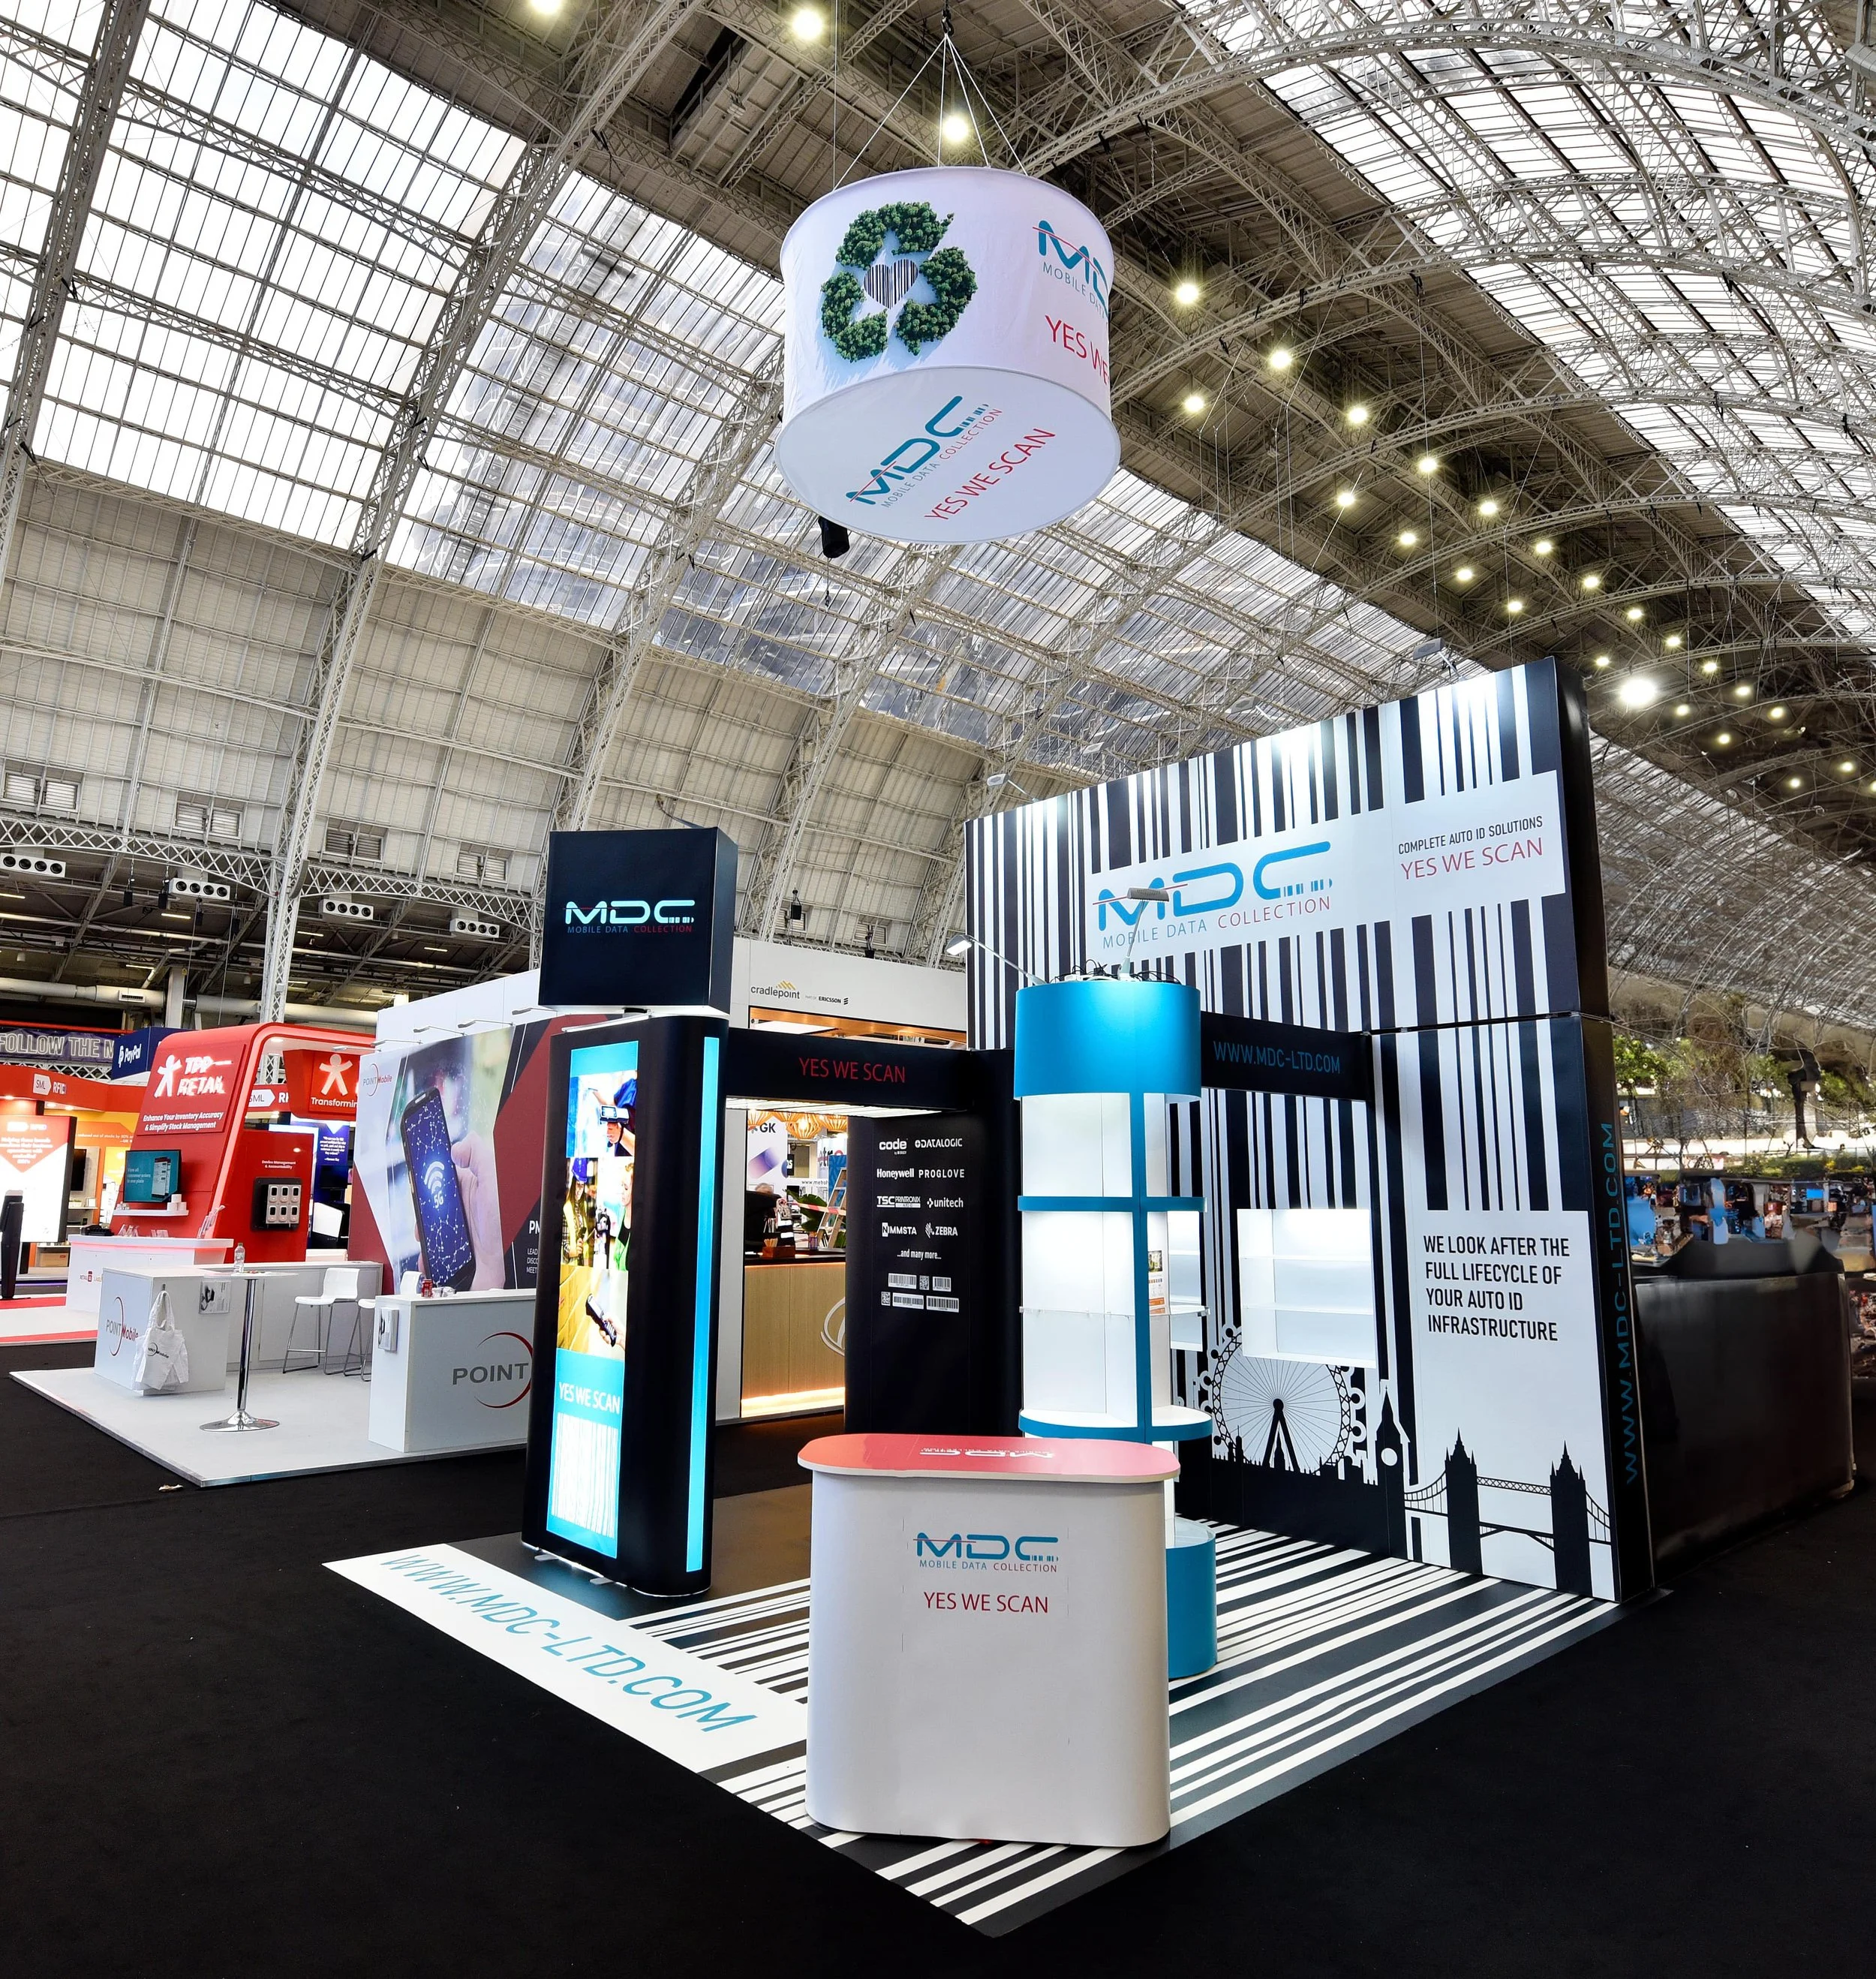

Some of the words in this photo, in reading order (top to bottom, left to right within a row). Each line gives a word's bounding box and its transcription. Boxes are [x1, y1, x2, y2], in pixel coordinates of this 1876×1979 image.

[1043, 261, 1086, 296] MOBILE
[1045, 315, 1087, 359] YES
[1090, 341, 1108, 385] WE
[846, 395, 989, 505] MDC
[881, 482, 915, 508] MOBILE
[912, 463, 940, 481] DATA
[940, 408, 1003, 460] COLLECTION
[924, 496, 968, 520] YES
[955, 473, 1000, 497] WE
[988, 428, 1056, 474] SCAN
[1399, 835, 1446, 855] COMPLETE
[1449, 829, 1473, 845] AUTO
[1476, 828, 1486, 840] ID
[1489, 816, 1543, 838] SOLUTIONS
[1401, 857, 1437, 880] YES
[1442, 850, 1476, 873] WE
[1482, 837, 1543, 866] SCAN
[1099, 841, 1332, 931] MDC
[565, 900, 696, 925] MDC
[1102, 927, 1159, 949] MOBILE
[1167, 919, 1207, 938] DATA
[1218, 895, 1330, 929] COLLECTION
[567, 925, 601, 934] MOBILE
[605, 925, 629, 934] DATA
[633, 925, 692, 933] COLLECTION
[750, 986, 800, 1000] cradlepoint
[68, 1036, 100, 1057] THE
[124, 1043, 142, 1064] PayPal
[1213, 1040, 1341, 1074] WWW.MDC-LTD.COM
[798, 1057, 829, 1078] YES
[832, 1060, 859, 1080] WE
[863, 1063, 905, 1084] SCAN
[36, 1079, 46, 1090] SML
[149, 1123, 169, 1132] Simplify
[182, 1121, 217, 1131] Management
[175, 1113, 199, 1121] Inventory
[198, 1111, 224, 1120] Accuracy
[759, 1123, 777, 1134] GK
[879, 1138, 907, 1150] code
[921, 1138, 963, 1148] DATALOGIC
[876, 1168, 915, 1180] Honeywell
[918, 1169, 965, 1178] PROGLOVE
[434, 1193, 444, 1209] 5G
[876, 1196, 895, 1205] TSC
[933, 1197, 964, 1208] unitech
[882, 1223, 917, 1237] NIMMSTA
[935, 1226, 958, 1236] ZEBRA
[910, 1250, 924, 1261] many
[1424, 1235, 1445, 1253] WE
[1448, 1236, 1487, 1255] LOOK
[1490, 1237, 1538, 1256] AFTER
[1540, 1238, 1570, 1257] THE
[1426, 1262, 1459, 1280] FULL
[1463, 1263, 1538, 1284] LIFECYCLE
[1542, 1265, 1562, 1285] OF
[1426, 1288, 1463, 1307] YOUR
[1467, 1291, 1505, 1310] AUTO
[1509, 1292, 1523, 1310] ID
[1600, 1123, 1639, 1485] WWW.MDC-LTD.COM
[106, 1319, 121, 1334] POINT
[1428, 1314, 1559, 1341] INFRASTRUCTURE
[452, 1362, 529, 1385] POINT
[559, 1381, 574, 1402] YES
[575, 1386, 591, 1408] WE
[592, 1391, 621, 1415] SCAN
[919, 1450, 1054, 1459] MDC
[917, 1532, 1059, 1562] MDC
[919, 1559, 958, 1569] MOBILE
[961, 1562, 987, 1570] DATA
[994, 1562, 1057, 1573] COLLECTION
[924, 1592, 957, 1611] YES
[961, 1593, 991, 1611] WE
[997, 1594, 1048, 1614] SCAN
[380, 1555, 756, 1733] WWW.MDC-LTD.COM
